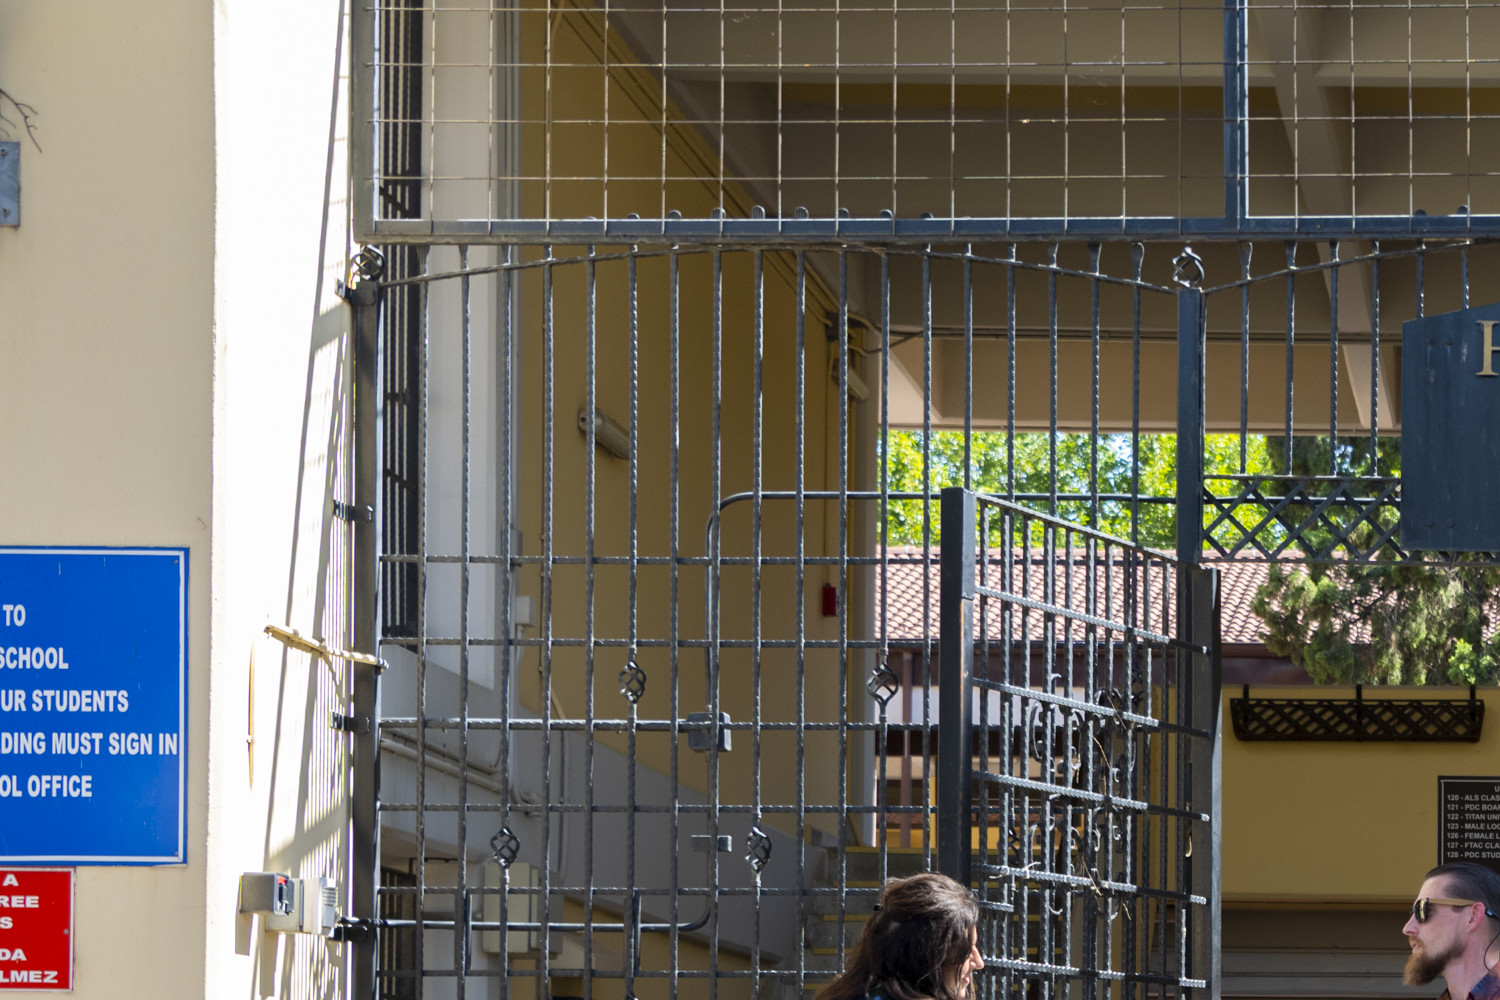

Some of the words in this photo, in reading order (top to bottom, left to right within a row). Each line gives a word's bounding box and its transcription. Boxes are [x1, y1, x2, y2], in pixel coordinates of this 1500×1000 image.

[3, 604, 26, 627] TO
[31, 690, 129, 713] STUDENTS
[52, 732, 103, 756] MUST
[108, 732, 153, 756] SIGN
[159, 733, 178, 756] IN
[27, 774, 93, 797] OFFICE
[3, 874, 19, 886] A
